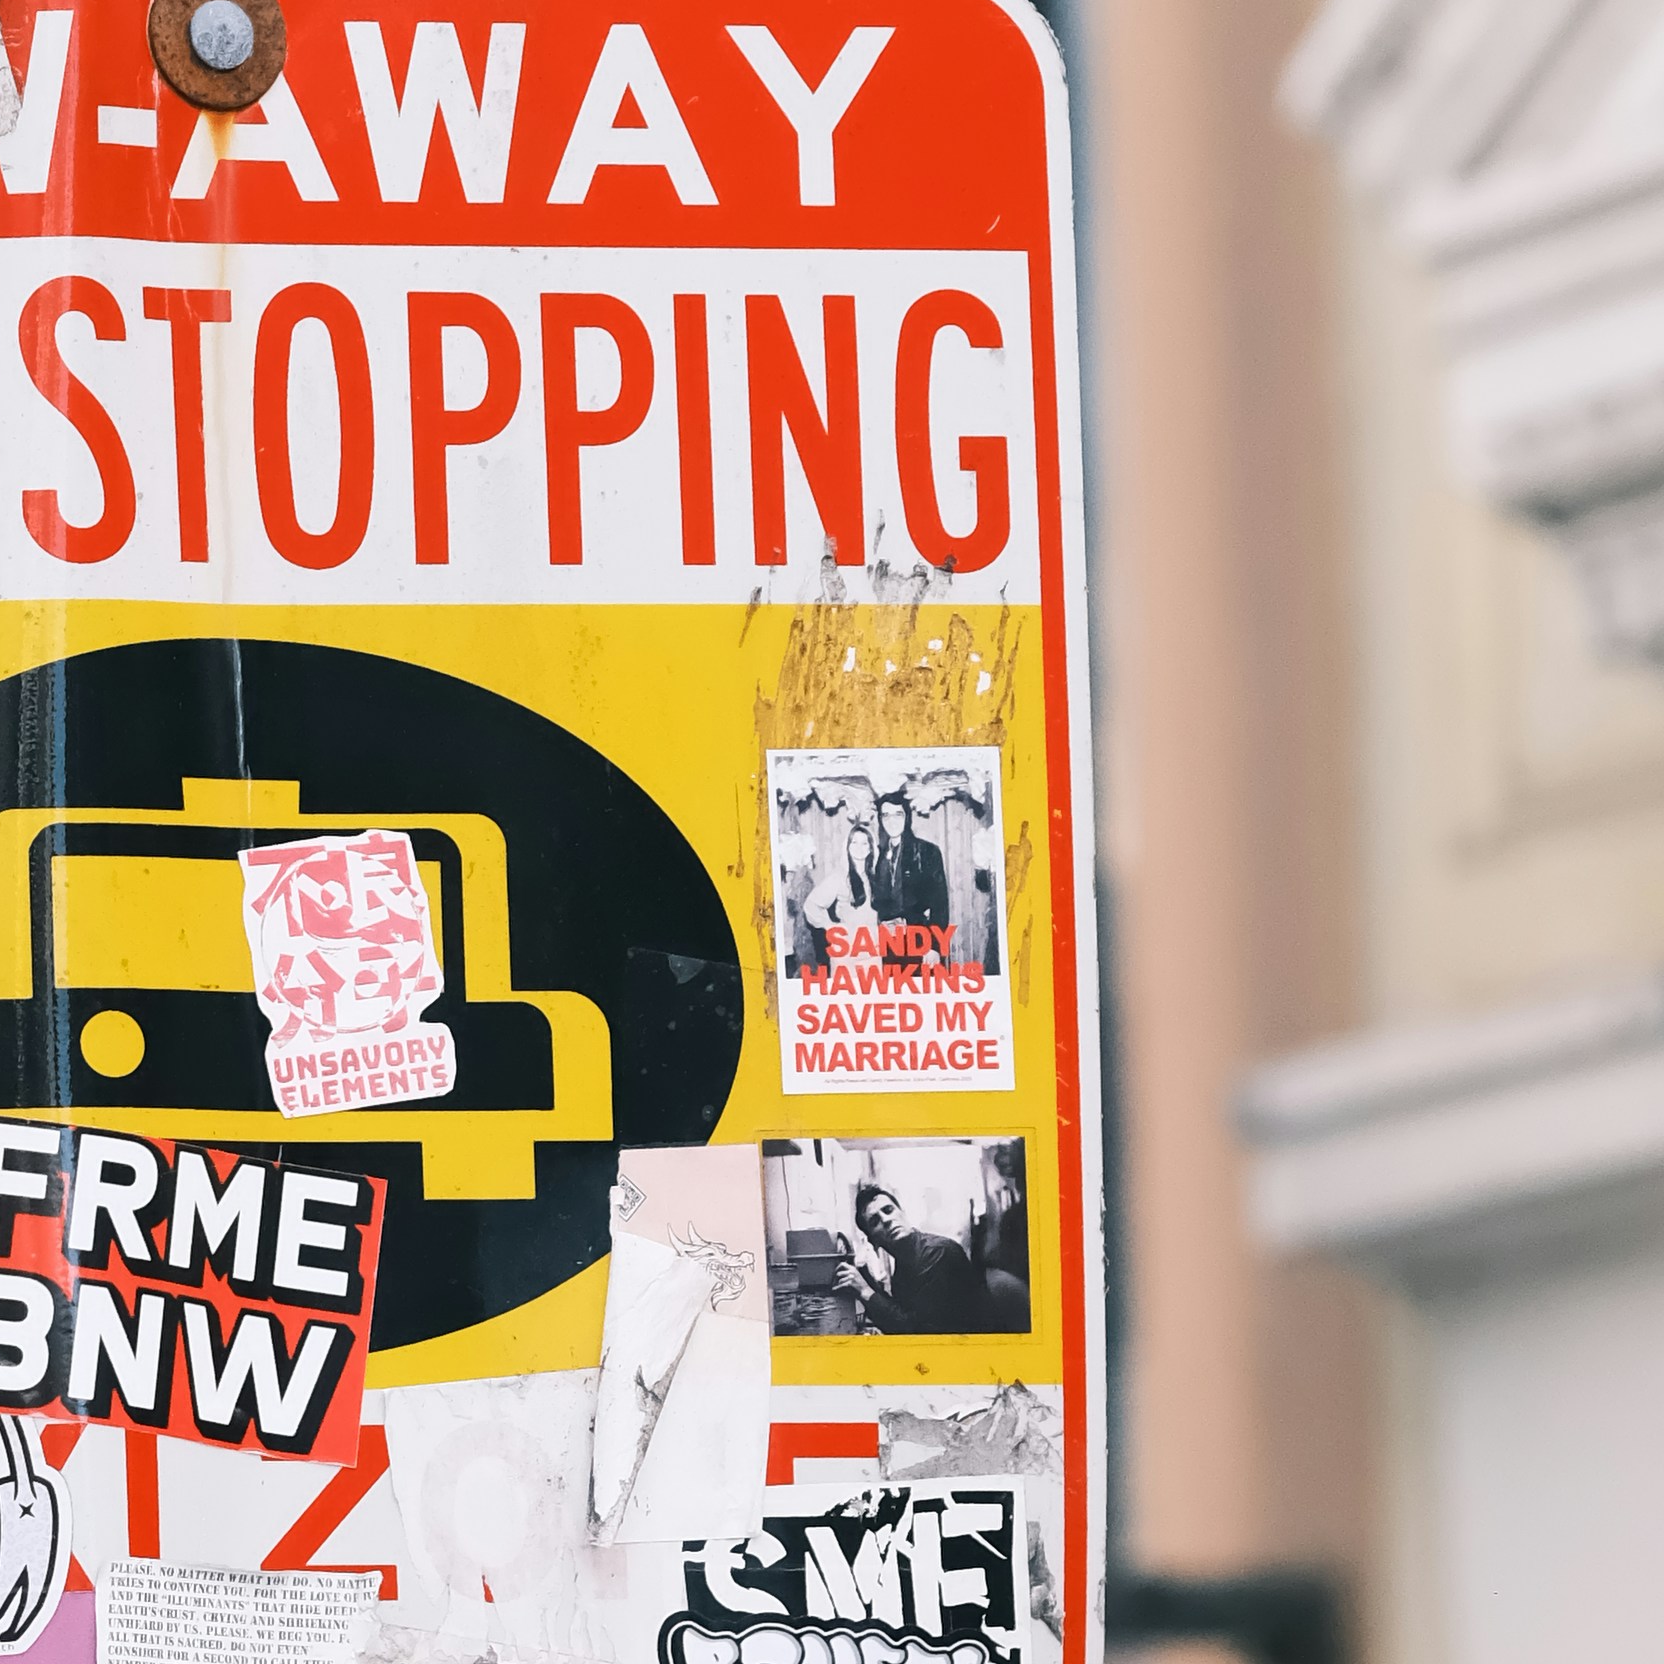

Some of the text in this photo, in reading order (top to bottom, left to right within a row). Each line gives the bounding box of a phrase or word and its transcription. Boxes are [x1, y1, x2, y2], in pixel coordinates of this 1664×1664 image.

[19, 274, 1014, 577] STOPPING
[824, 924, 959, 958] SANDY
[800, 961, 986, 996] HAWKINS
[796, 1001, 994, 1035] SAVED MY
[272, 1035, 446, 1084] UNSAVORY
[794, 1039, 1001, 1073] MARRIAGE
[280, 1064, 449, 1111] ELEMENTS
[110, 1577, 144, 1588] TRIES
[148, 1579, 161, 1589] TO
[164, 1581, 220, 1594] CONVINCE
[254, 1588, 277, 1599] FOR
[281, 1590, 306, 1601] THE
[310, 1591, 341, 1602] LOVE
[160, 1567, 174, 1577] NO
[178, 1568, 224, 1582] MATTER
[229, 1573, 263, 1585] WHAT
[267, 1575, 289, 1586] YOU
[316, 1578, 333, 1588] NO
[108, 1604, 157, 1617] EARTH'S
[203, 1612, 247, 1624] CRYING
[251, 1615, 275, 1627] AND
[278, 1617, 349, 1630] SHRIEKING
[110, 1590, 133, 1601] AND
[136, 1592, 158, 1603] THE
[253, 1602, 286, 1614] THAT
[290, 1604, 321, 1615] RIDE
[108, 1617, 163, 1631] UNHEARD
[167, 1622, 179, 1633] BY
[257, 1629, 275, 1640] WE
[278, 1631, 302, 1642] BEG
[108, 1632, 129, 1642] ALL
[132, 1633, 161, 1645] THAT
[165, 1636, 175, 1646] IS
[231, 1641, 246, 1651] DO
[250, 1643, 274, 1654] NOT
[277, 1644, 309, 1655] EVEN
[108, 1645, 164, 1659] CONSIDER
[167, 1650, 189, 1661] FOR
[194, 1652, 201, 1662] A
